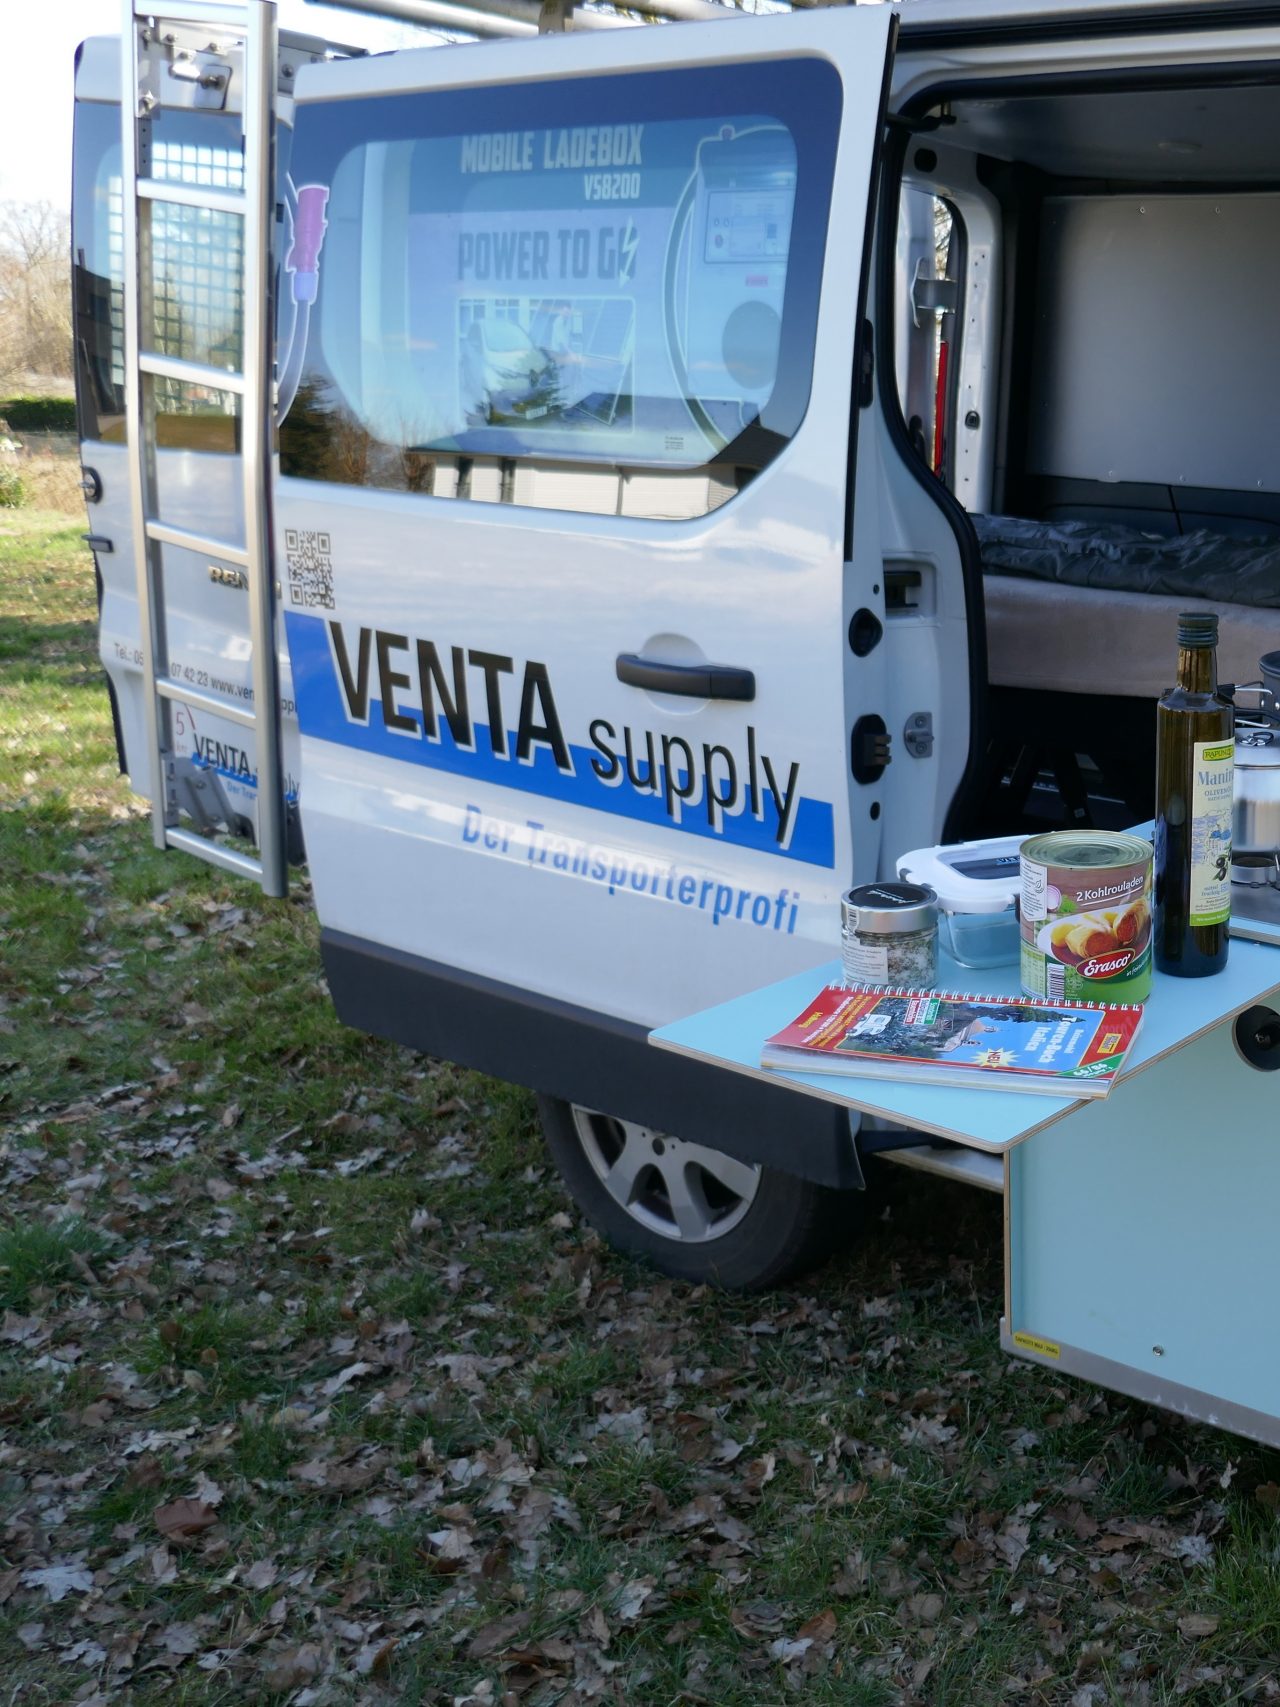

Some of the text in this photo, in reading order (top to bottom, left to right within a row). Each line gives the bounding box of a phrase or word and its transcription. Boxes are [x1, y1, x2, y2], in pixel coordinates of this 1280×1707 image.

[461, 124, 644, 174] MOBILE LADEBOX
[458, 230, 549, 281] POWER
[557, 229, 590, 280] TO
[184, 667, 194, 682] 42
[197, 671, 208, 687] 23
[328, 620, 800, 845] VENTA supply
[194, 733, 251, 778] VENTA
[461, 803, 801, 934] Der Transporterprofi
[1076, 875, 1144, 902] 2 Kohlrouladen
[1083, 953, 1131, 977] Erasco
[987, 1051, 1001, 1063] NEU
[1024, 1026, 1052, 1051] Italien
[1037, 1016, 1078, 1063] Touren-Buch
